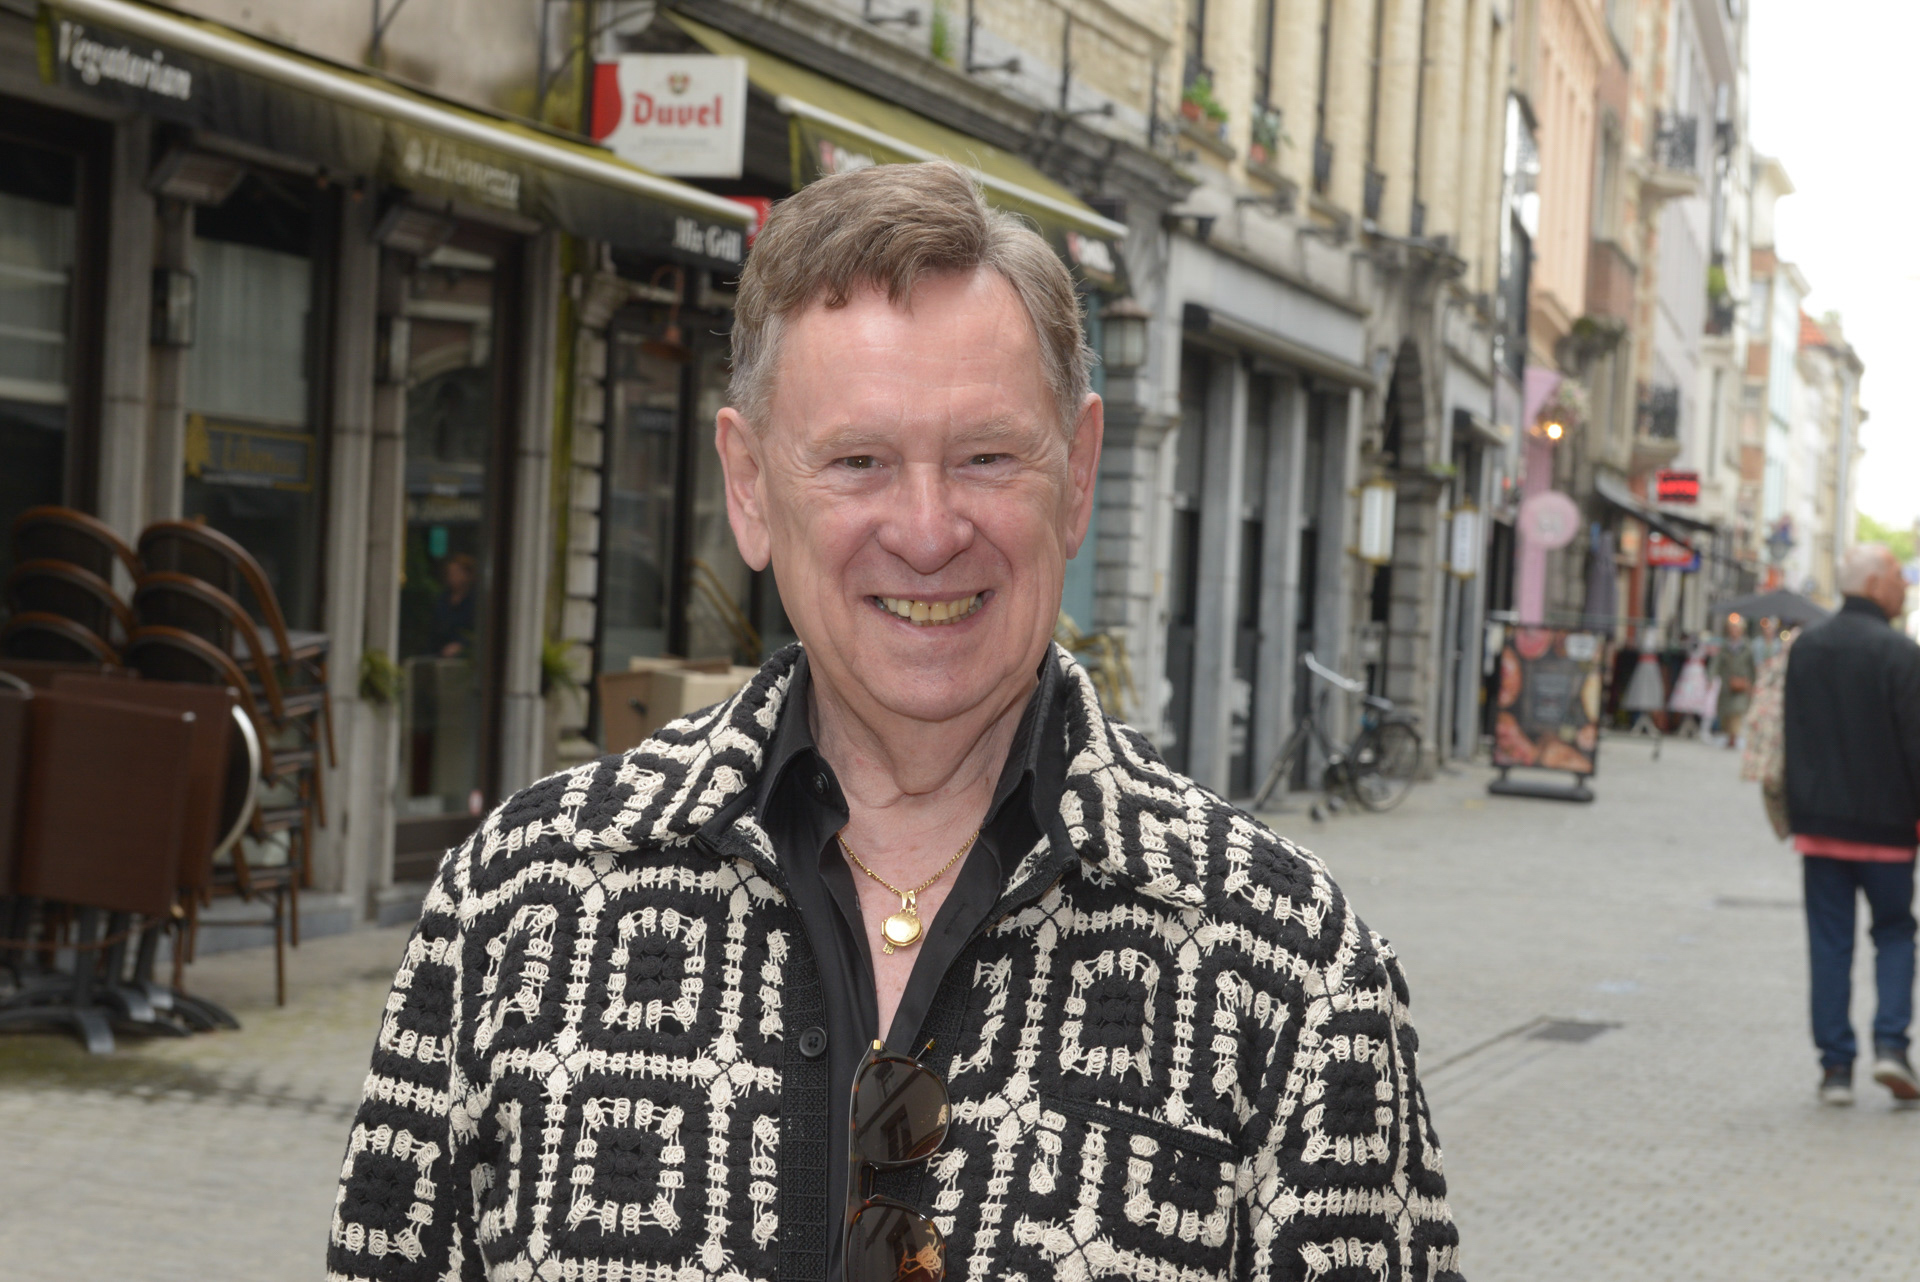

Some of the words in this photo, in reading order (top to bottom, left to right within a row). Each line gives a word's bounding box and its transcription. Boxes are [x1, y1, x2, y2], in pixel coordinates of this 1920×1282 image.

[633, 91, 723, 127] Duvel
[673, 215, 704, 253] Mix
[704, 223, 742, 264] Grill
